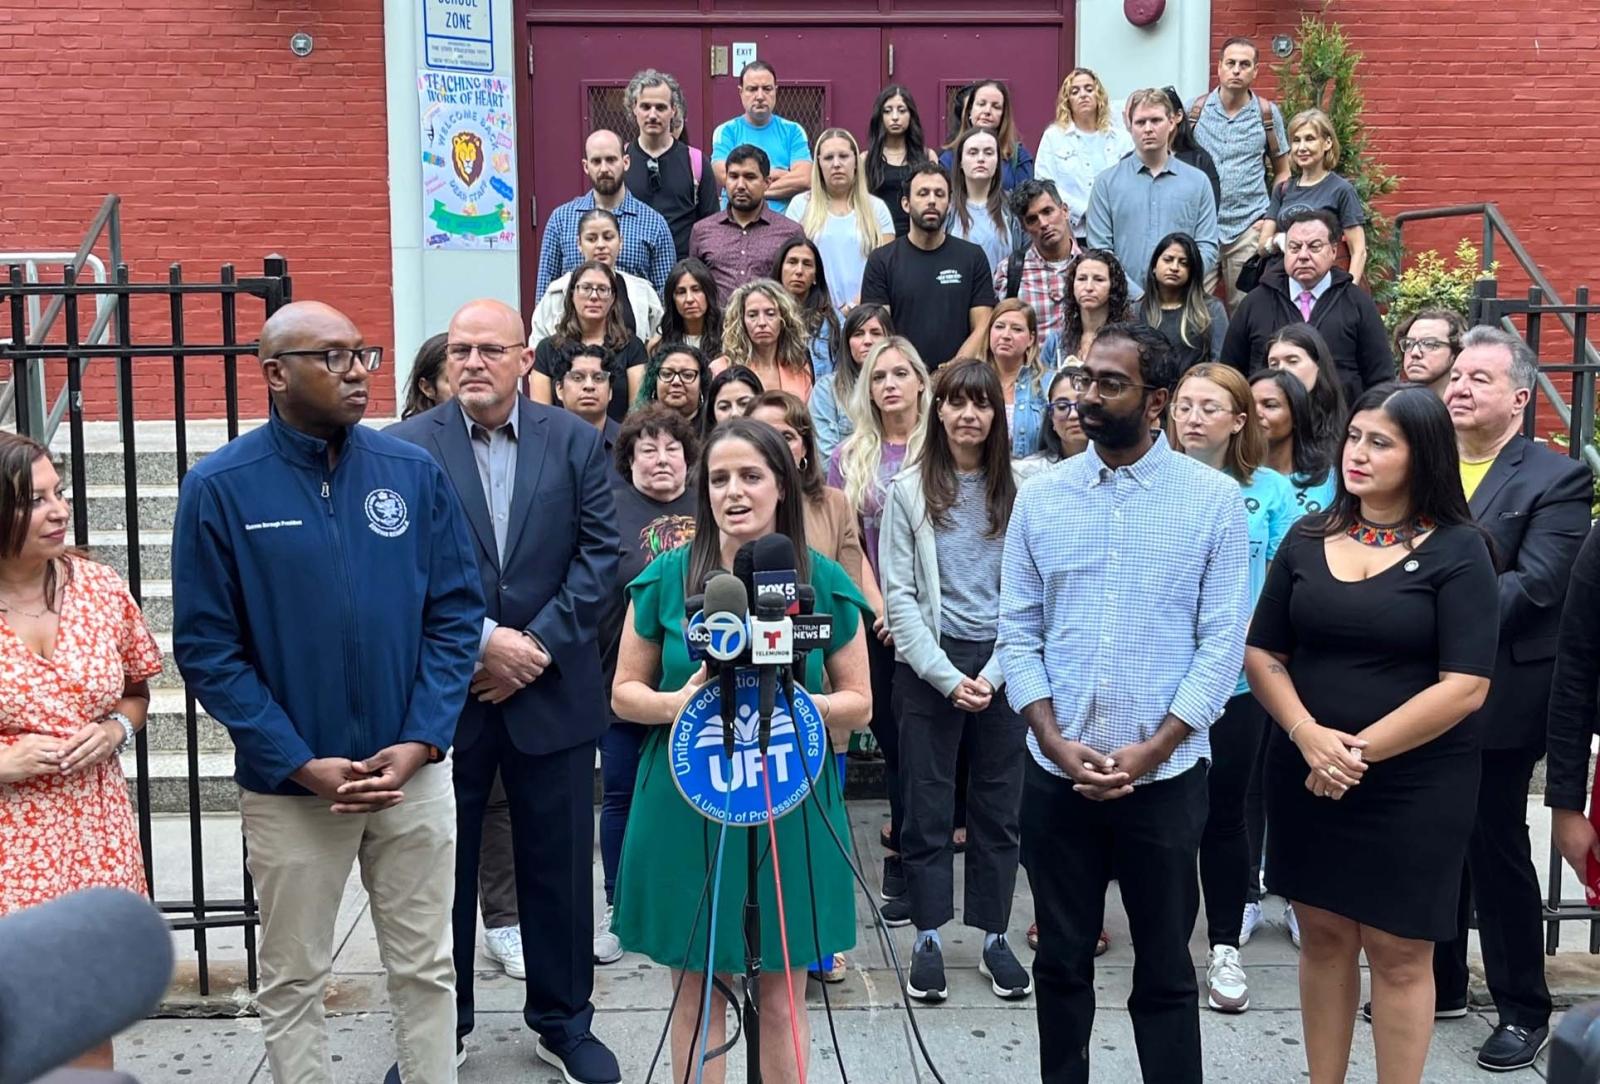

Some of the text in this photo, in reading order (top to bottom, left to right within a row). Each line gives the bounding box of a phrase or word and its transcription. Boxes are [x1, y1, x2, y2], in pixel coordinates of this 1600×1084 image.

[445, 12, 472, 30] ZONE
[736, 48, 752, 56] EXIT
[426, 73, 481, 93] TEACHING
[427, 89, 504, 108] WORK OF HEART
[438, 109, 479, 147] WELCOME
[688, 629, 711, 642] abc
[706, 619, 742, 658] 7
[793, 631, 819, 639] NEWS
[675, 721, 693, 776] United
[685, 674, 760, 719] Fedetio
[708, 743, 794, 793] UFT
[691, 793, 702, 805] A
[735, 811, 747, 822] of
[749, 776, 812, 822] Proessional
